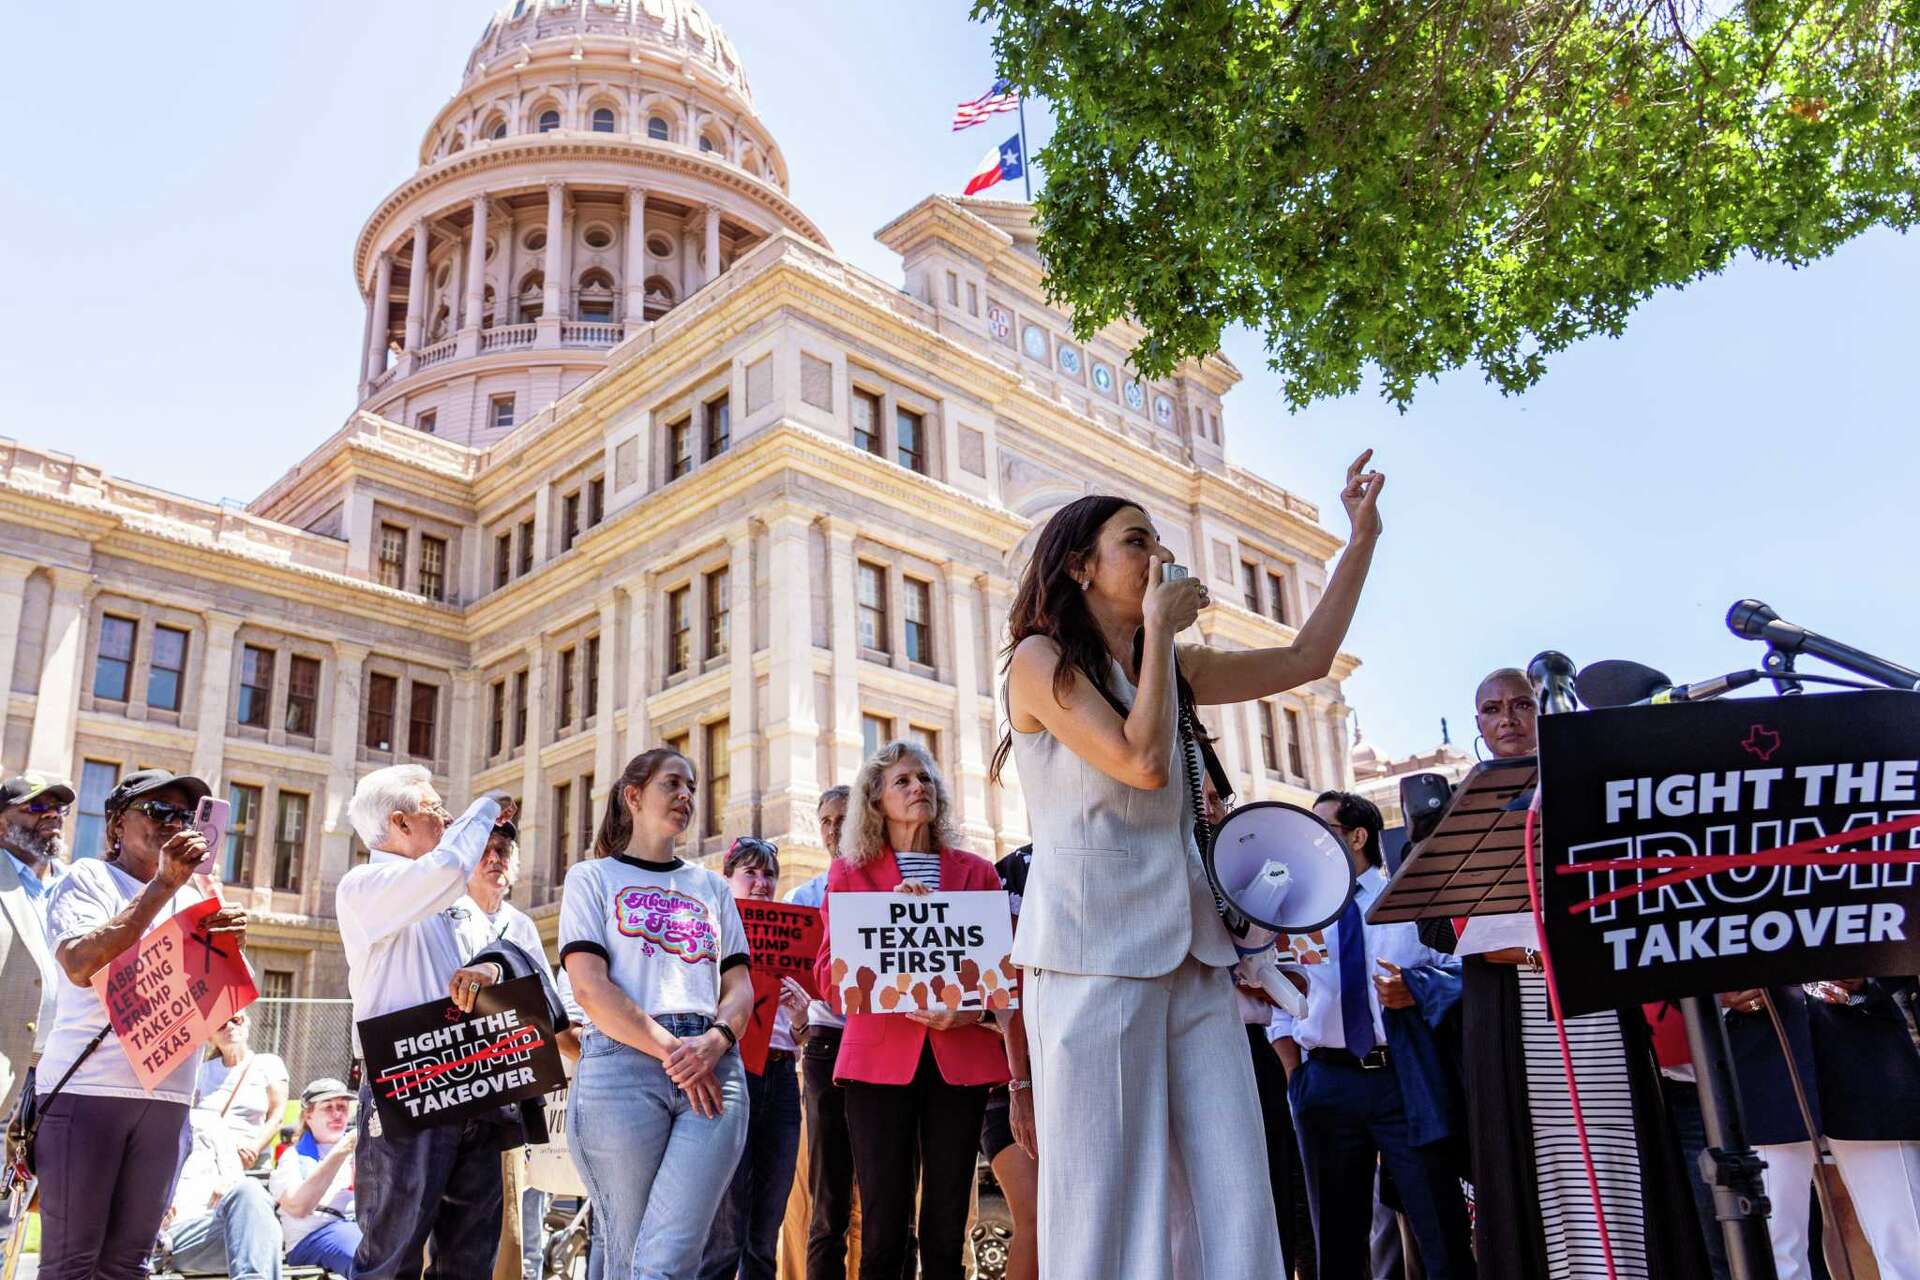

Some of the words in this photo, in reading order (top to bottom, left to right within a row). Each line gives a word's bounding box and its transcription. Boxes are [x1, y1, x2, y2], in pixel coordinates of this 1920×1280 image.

[1605, 767, 1784, 824] FIGHT
[1795, 760, 1920, 807] THE
[744, 908, 814, 927] BBOTT'S
[858, 925, 984, 950] TEXANS
[889, 902, 949, 925] PUT
[1603, 903, 1907, 971] TAKEOVER
[107, 935, 173, 996] ABBOTT'S
[879, 950, 966, 975] FIRST
[113, 960, 174, 1017] LETTING
[121, 985, 171, 1031] TRUMP
[130, 1014, 173, 1051] TAKE
[170, 979, 209, 1017] OVER
[394, 1021, 468, 1060] FIGHT
[470, 1009, 520, 1035] THE
[142, 1026, 191, 1074] TEXAS
[381, 1025, 541, 1100] TRUMP
[405, 1066, 537, 1118] TAKEOVER
